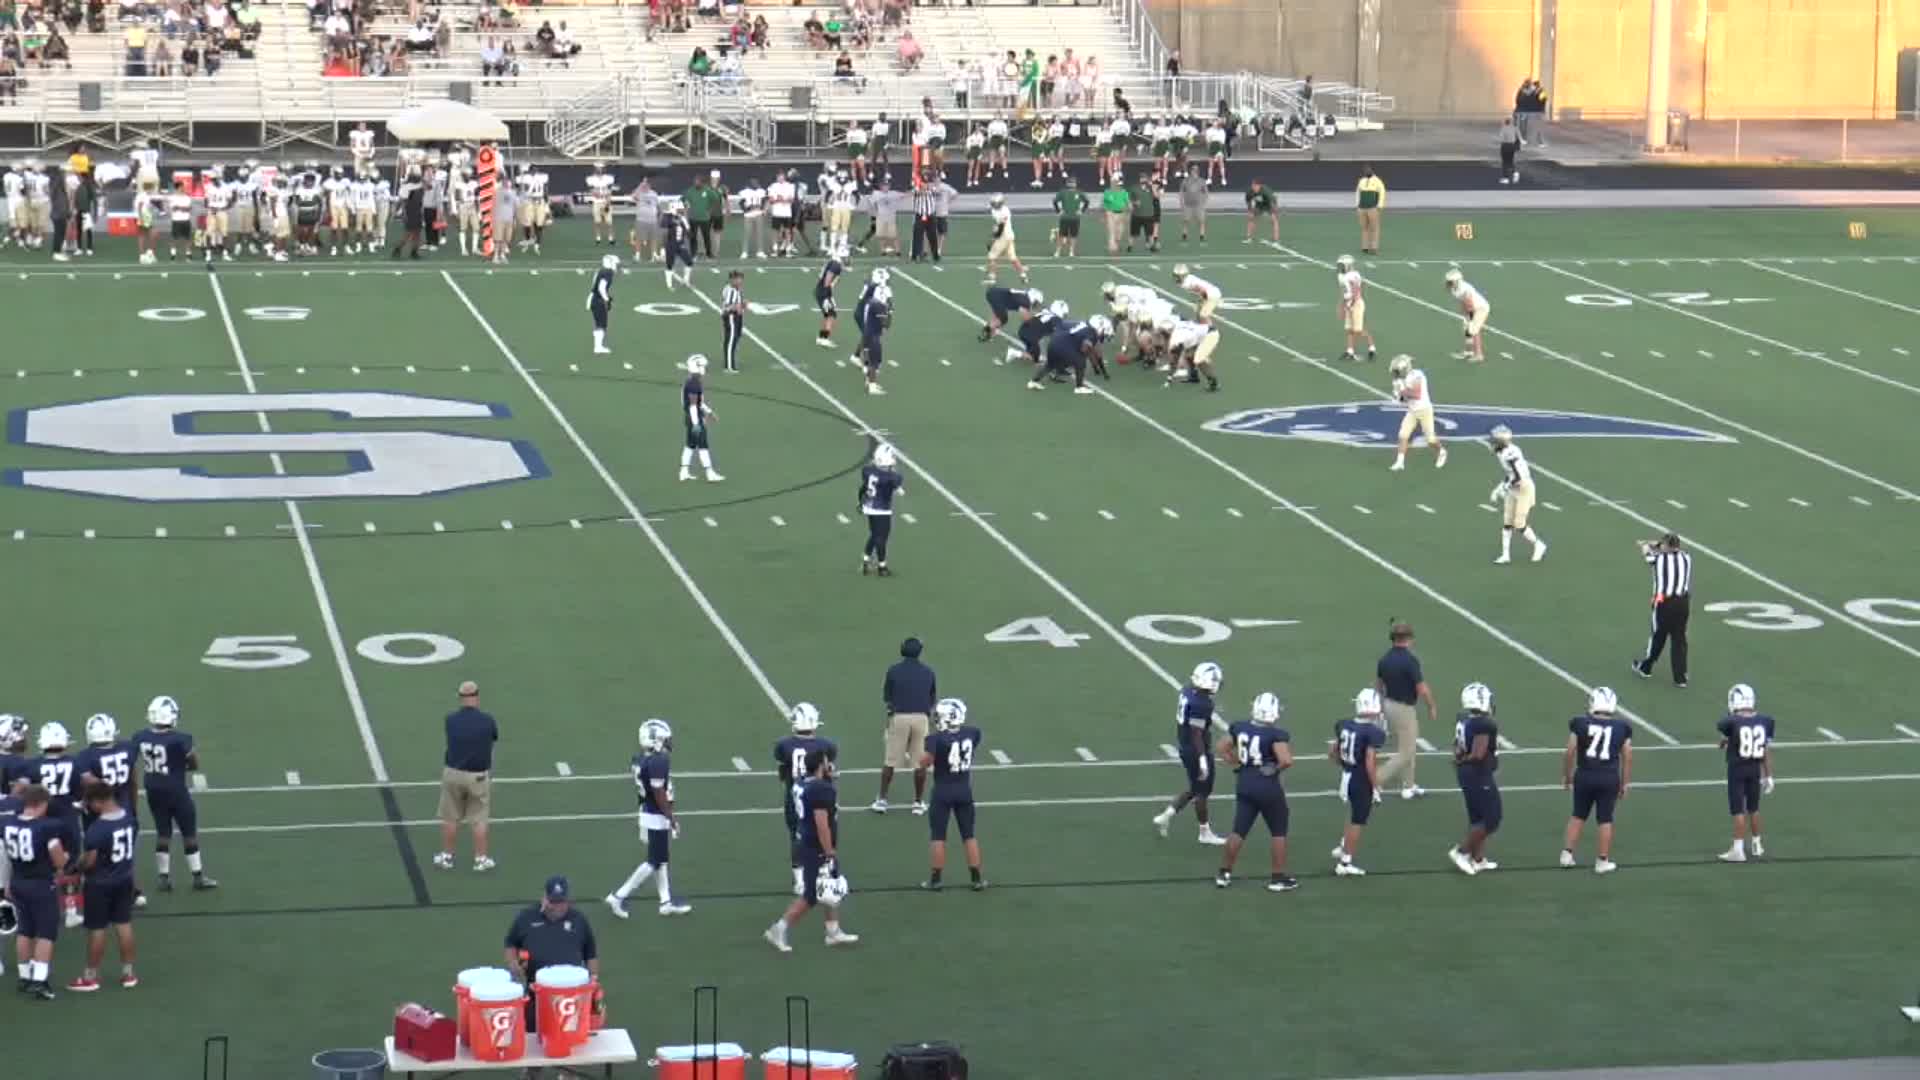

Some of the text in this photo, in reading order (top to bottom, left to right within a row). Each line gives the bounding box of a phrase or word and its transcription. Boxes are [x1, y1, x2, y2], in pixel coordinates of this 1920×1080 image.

[866, 474, 879, 497] 5
[140, 742, 168, 774] 52
[948, 738, 976, 772] 43
[1237, 732, 1263, 766] 64
[1339, 729, 1357, 763] 21
[1586, 724, 1613, 760] 71
[1739, 724, 1766, 758] 82
[39, 761, 73, 796] 27
[99, 751, 130, 786] 55
[4, 825, 35, 863] 58
[111, 827, 133, 864] 51
[493, 1012, 511, 1030] G
[559, 998, 576, 1015] G
